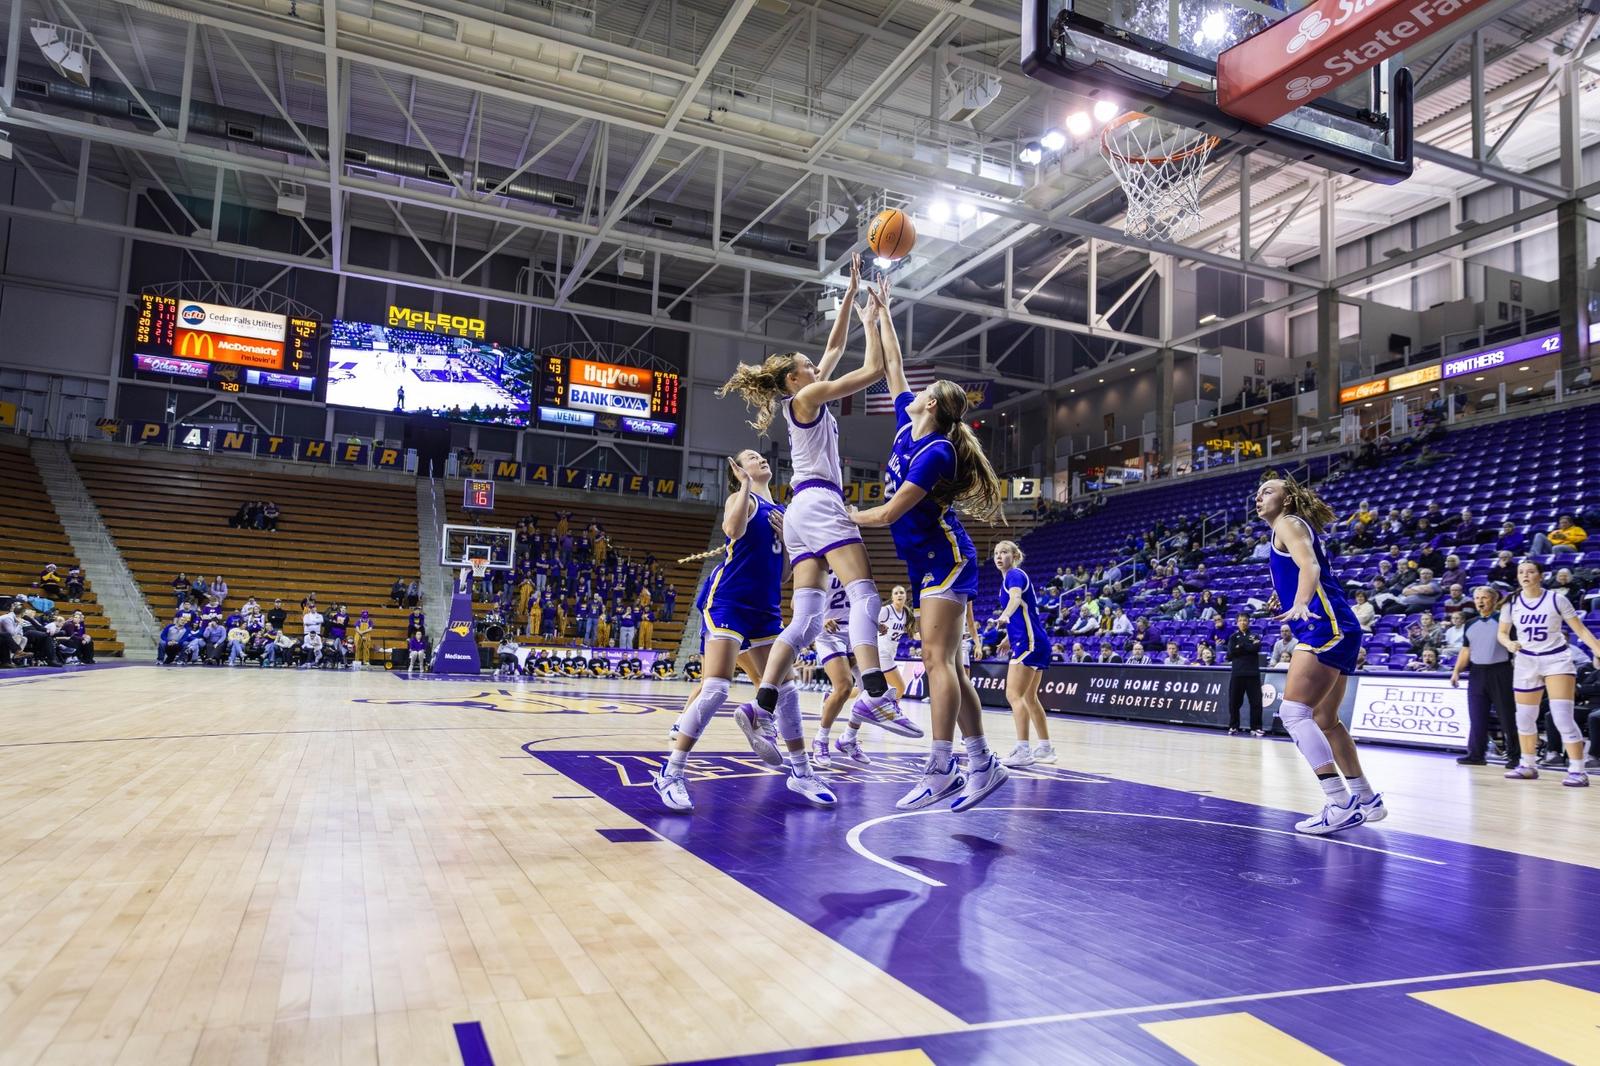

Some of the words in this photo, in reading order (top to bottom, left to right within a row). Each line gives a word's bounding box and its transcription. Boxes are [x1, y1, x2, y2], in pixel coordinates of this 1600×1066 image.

[143, 310, 151, 318] 15
[389, 305, 485, 331] McLEOD
[140, 318, 150, 326] 20
[209, 313, 232, 322] Cedar
[234, 316, 251, 325] Falls
[252, 319, 283, 330] Utilities
[296, 326, 310, 338] 42
[388, 318, 485, 339] CENTER
[138, 334, 148, 342] 23
[294, 338, 301, 348] 3
[218, 340, 279, 356] McDonald's
[296, 350, 303, 359] 0
[1445, 351, 1505, 376] PANTHERS
[1541, 337, 1560, 352] 42
[292, 362, 299, 370] 4
[549, 364, 561, 374] 43
[556, 376, 562, 384] 4
[220, 382, 239, 392] 7:20
[558, 386, 563, 395] 0
[571, 389, 608, 406] BANK
[610, 396, 644, 411] IOWA
[1520, 614, 1548, 624] UNI
[1522, 626, 1548, 642] 15
[1090, 678, 1119, 689] YOUR
[1124, 680, 1160, 692] HOME
[1164, 682, 1199, 694] SOLD
[1206, 683, 1221, 695] IN
[1385, 688, 1444, 703] ELITE
[1085, 692, 1106, 704] THE
[1110, 694, 1173, 709] SHORTEST
[1180, 699, 1218, 713] TIME!
[1369, 700, 1455, 718] CASINO
[1362, 713, 1460, 733] RESORTS
